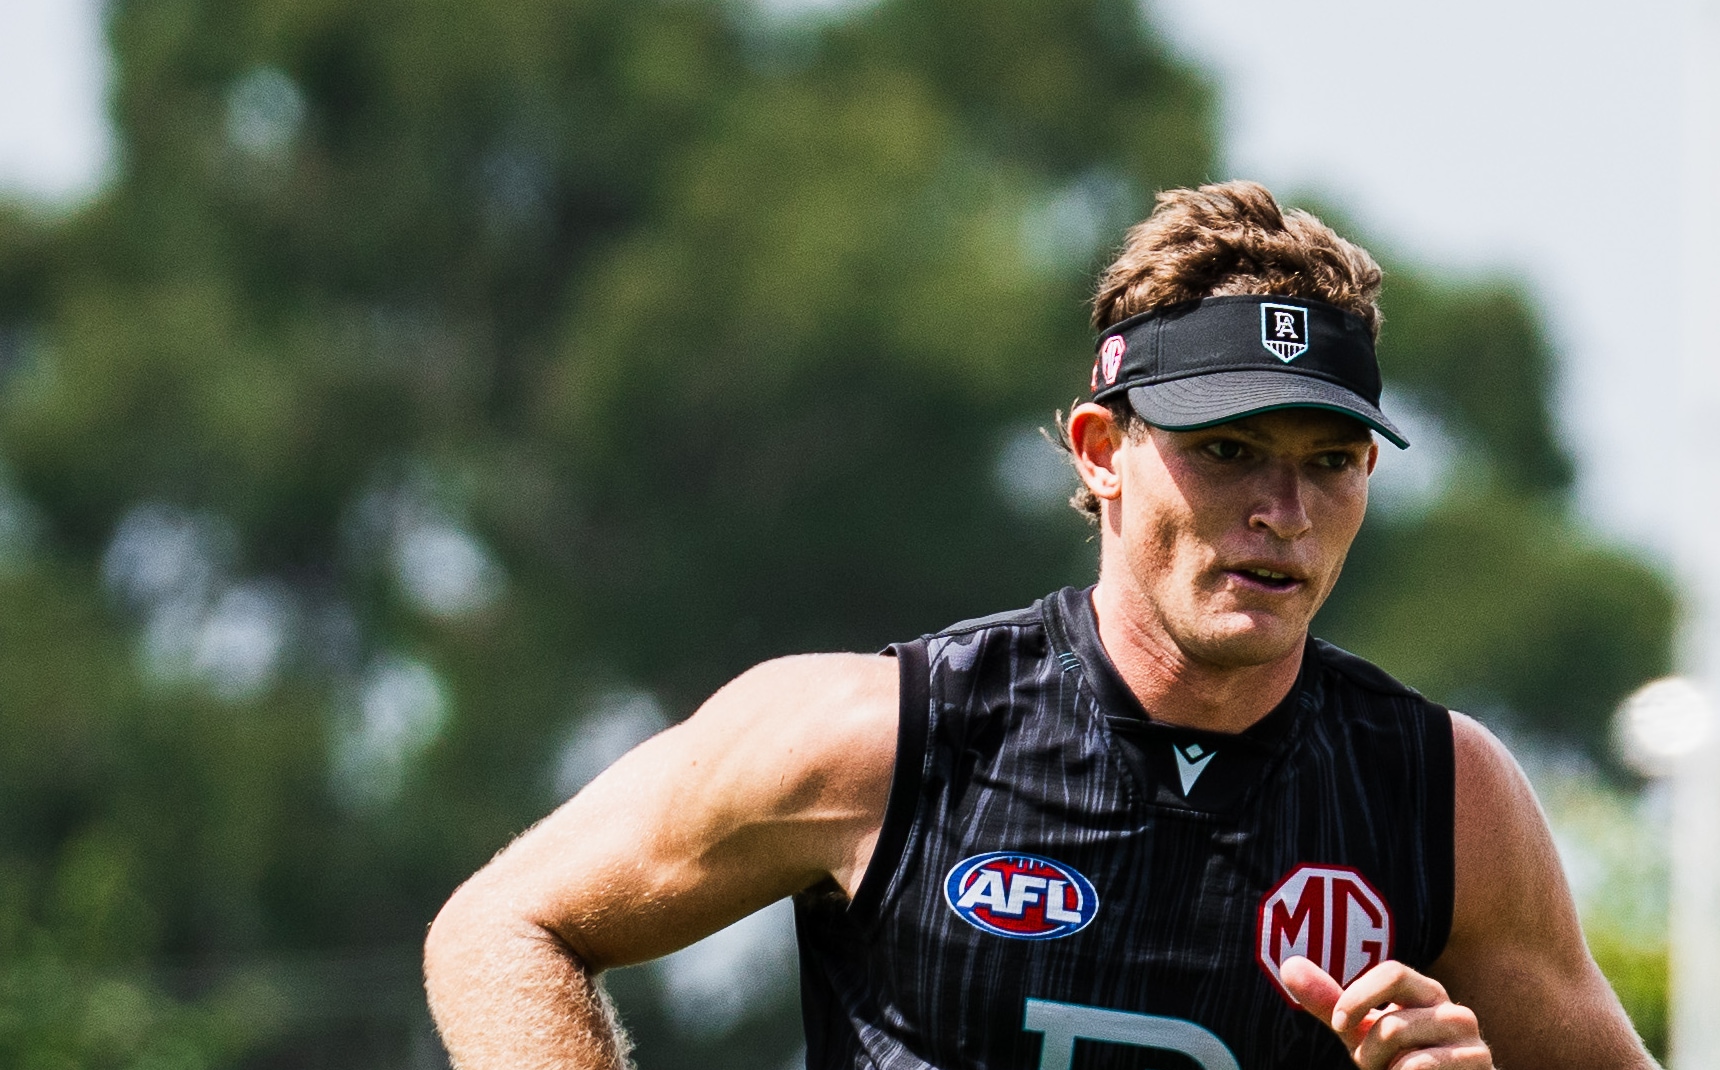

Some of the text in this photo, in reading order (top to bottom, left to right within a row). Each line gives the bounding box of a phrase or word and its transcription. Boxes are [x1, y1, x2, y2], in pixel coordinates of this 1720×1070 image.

[1274, 311, 1299, 338] PA
[957, 868, 1082, 924] AFL
[1268, 875, 1384, 991] MG
